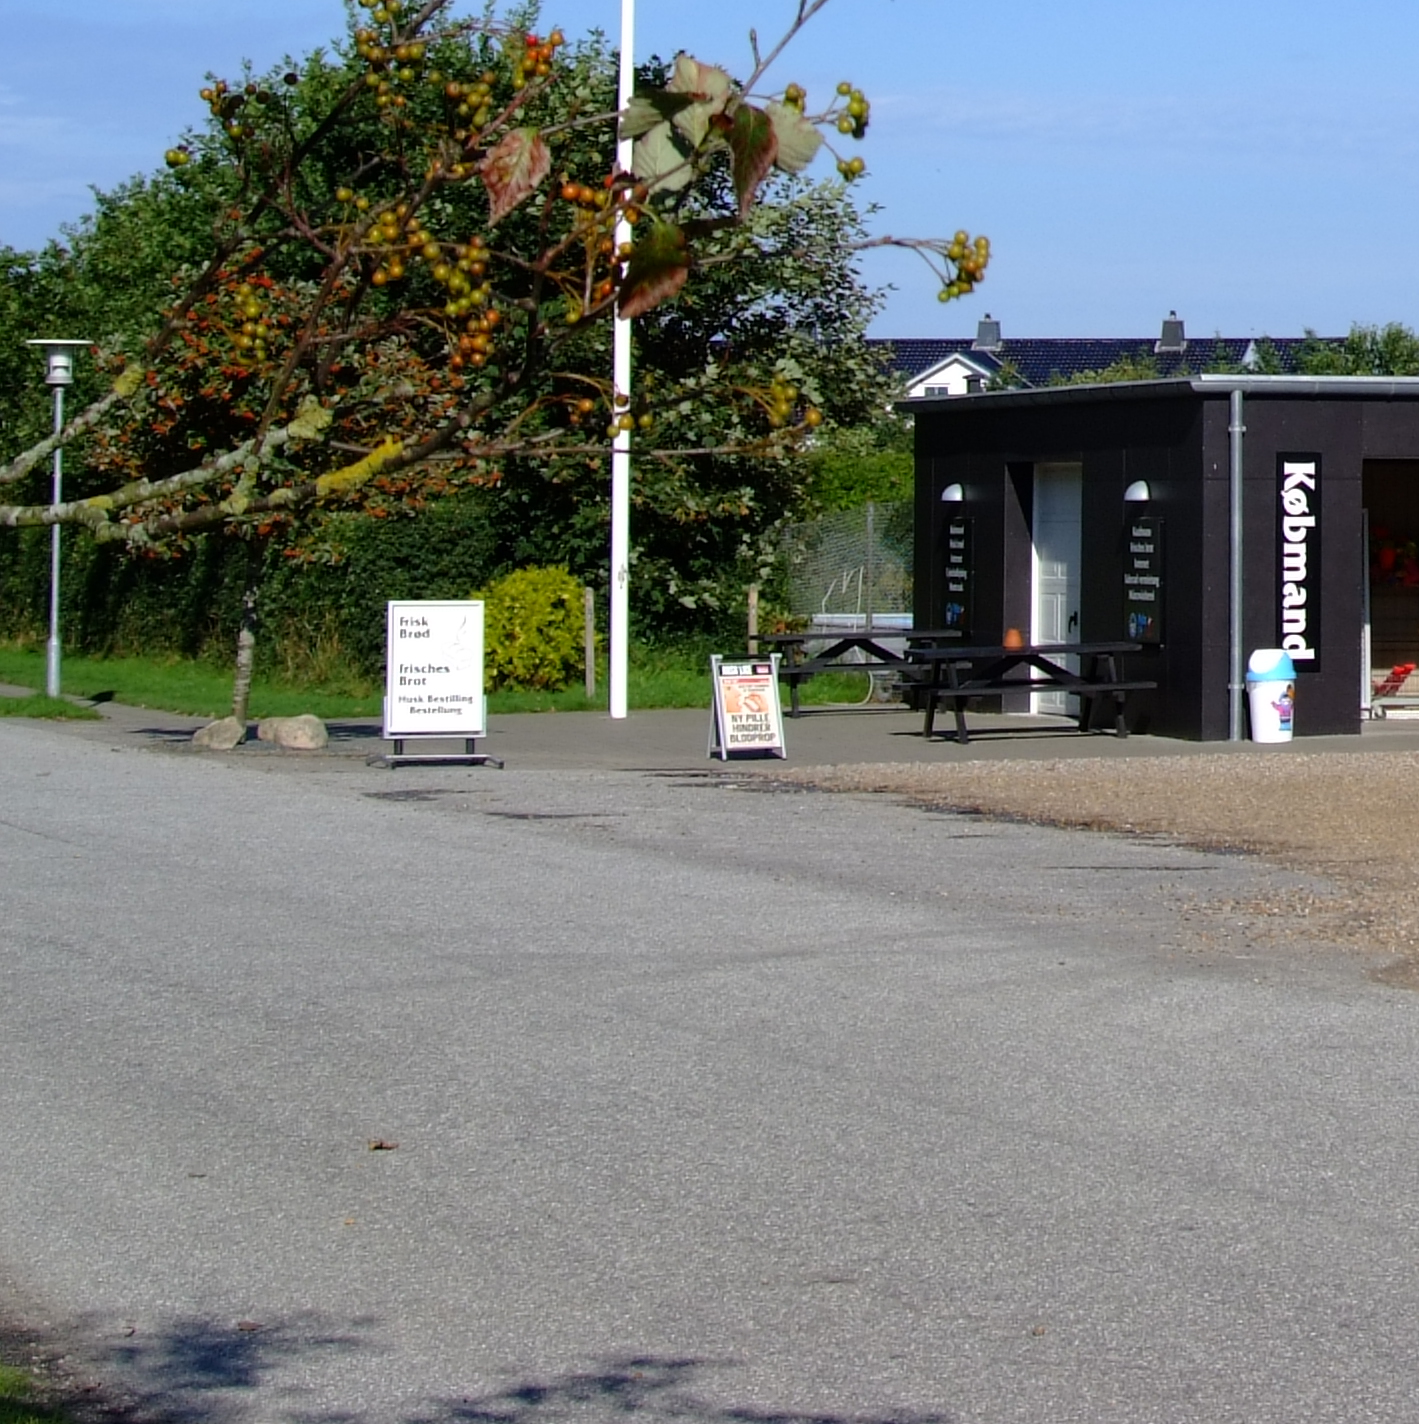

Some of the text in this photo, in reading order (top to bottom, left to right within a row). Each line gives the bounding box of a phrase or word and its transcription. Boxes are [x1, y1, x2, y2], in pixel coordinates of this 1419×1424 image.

[1281, 461, 1316, 660] Købmand
[400, 629, 430, 639] Brød
[399, 676, 427, 686] Brot
